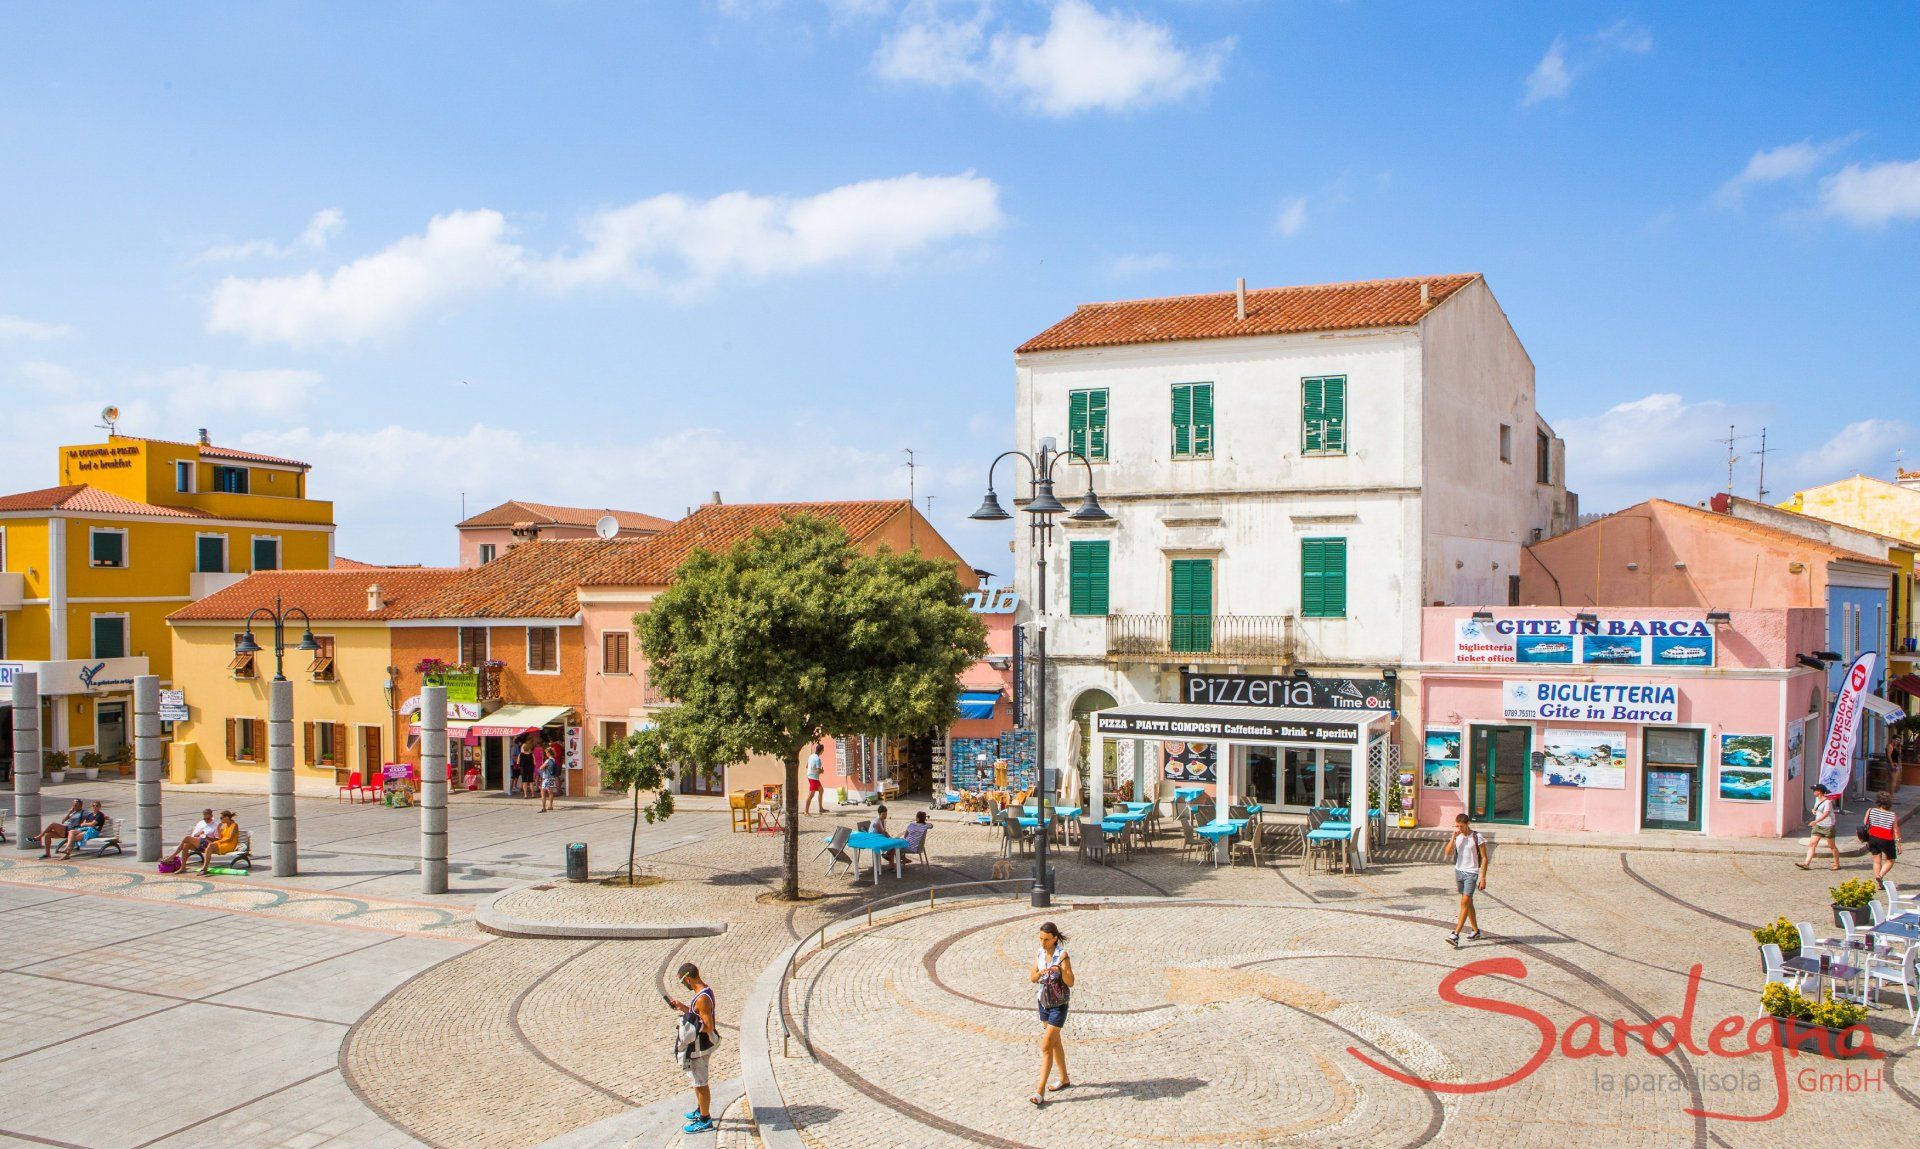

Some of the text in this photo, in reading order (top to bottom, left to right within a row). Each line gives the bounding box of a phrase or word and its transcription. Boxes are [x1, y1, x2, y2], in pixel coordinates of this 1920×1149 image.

[1496, 619, 1711, 636] GITE IN BARCA
[1458, 643, 1513, 653] biglietteria
[1457, 654, 1515, 663] ticket office
[1331, 695, 1391, 709] Time Out
[1537, 683, 1675, 704] BIGLIETTERIA
[1540, 703, 1673, 721] Gite in Barca
[1845, 696, 1856, 733] ISOLE
[481, 727, 513, 735] GELATERIA
[1098, 718, 1128, 729] PIZZA
[1136, 720, 1169, 731] PIATTI
[1171, 722, 1222, 733] COMPOSTI
[1224, 724, 1273, 735] Caffetteria
[1281, 726, 1307, 737] Drink
[1316, 728, 1358, 740] Aperitivi
[1825, 689, 1851, 767] ESCURSIONI
